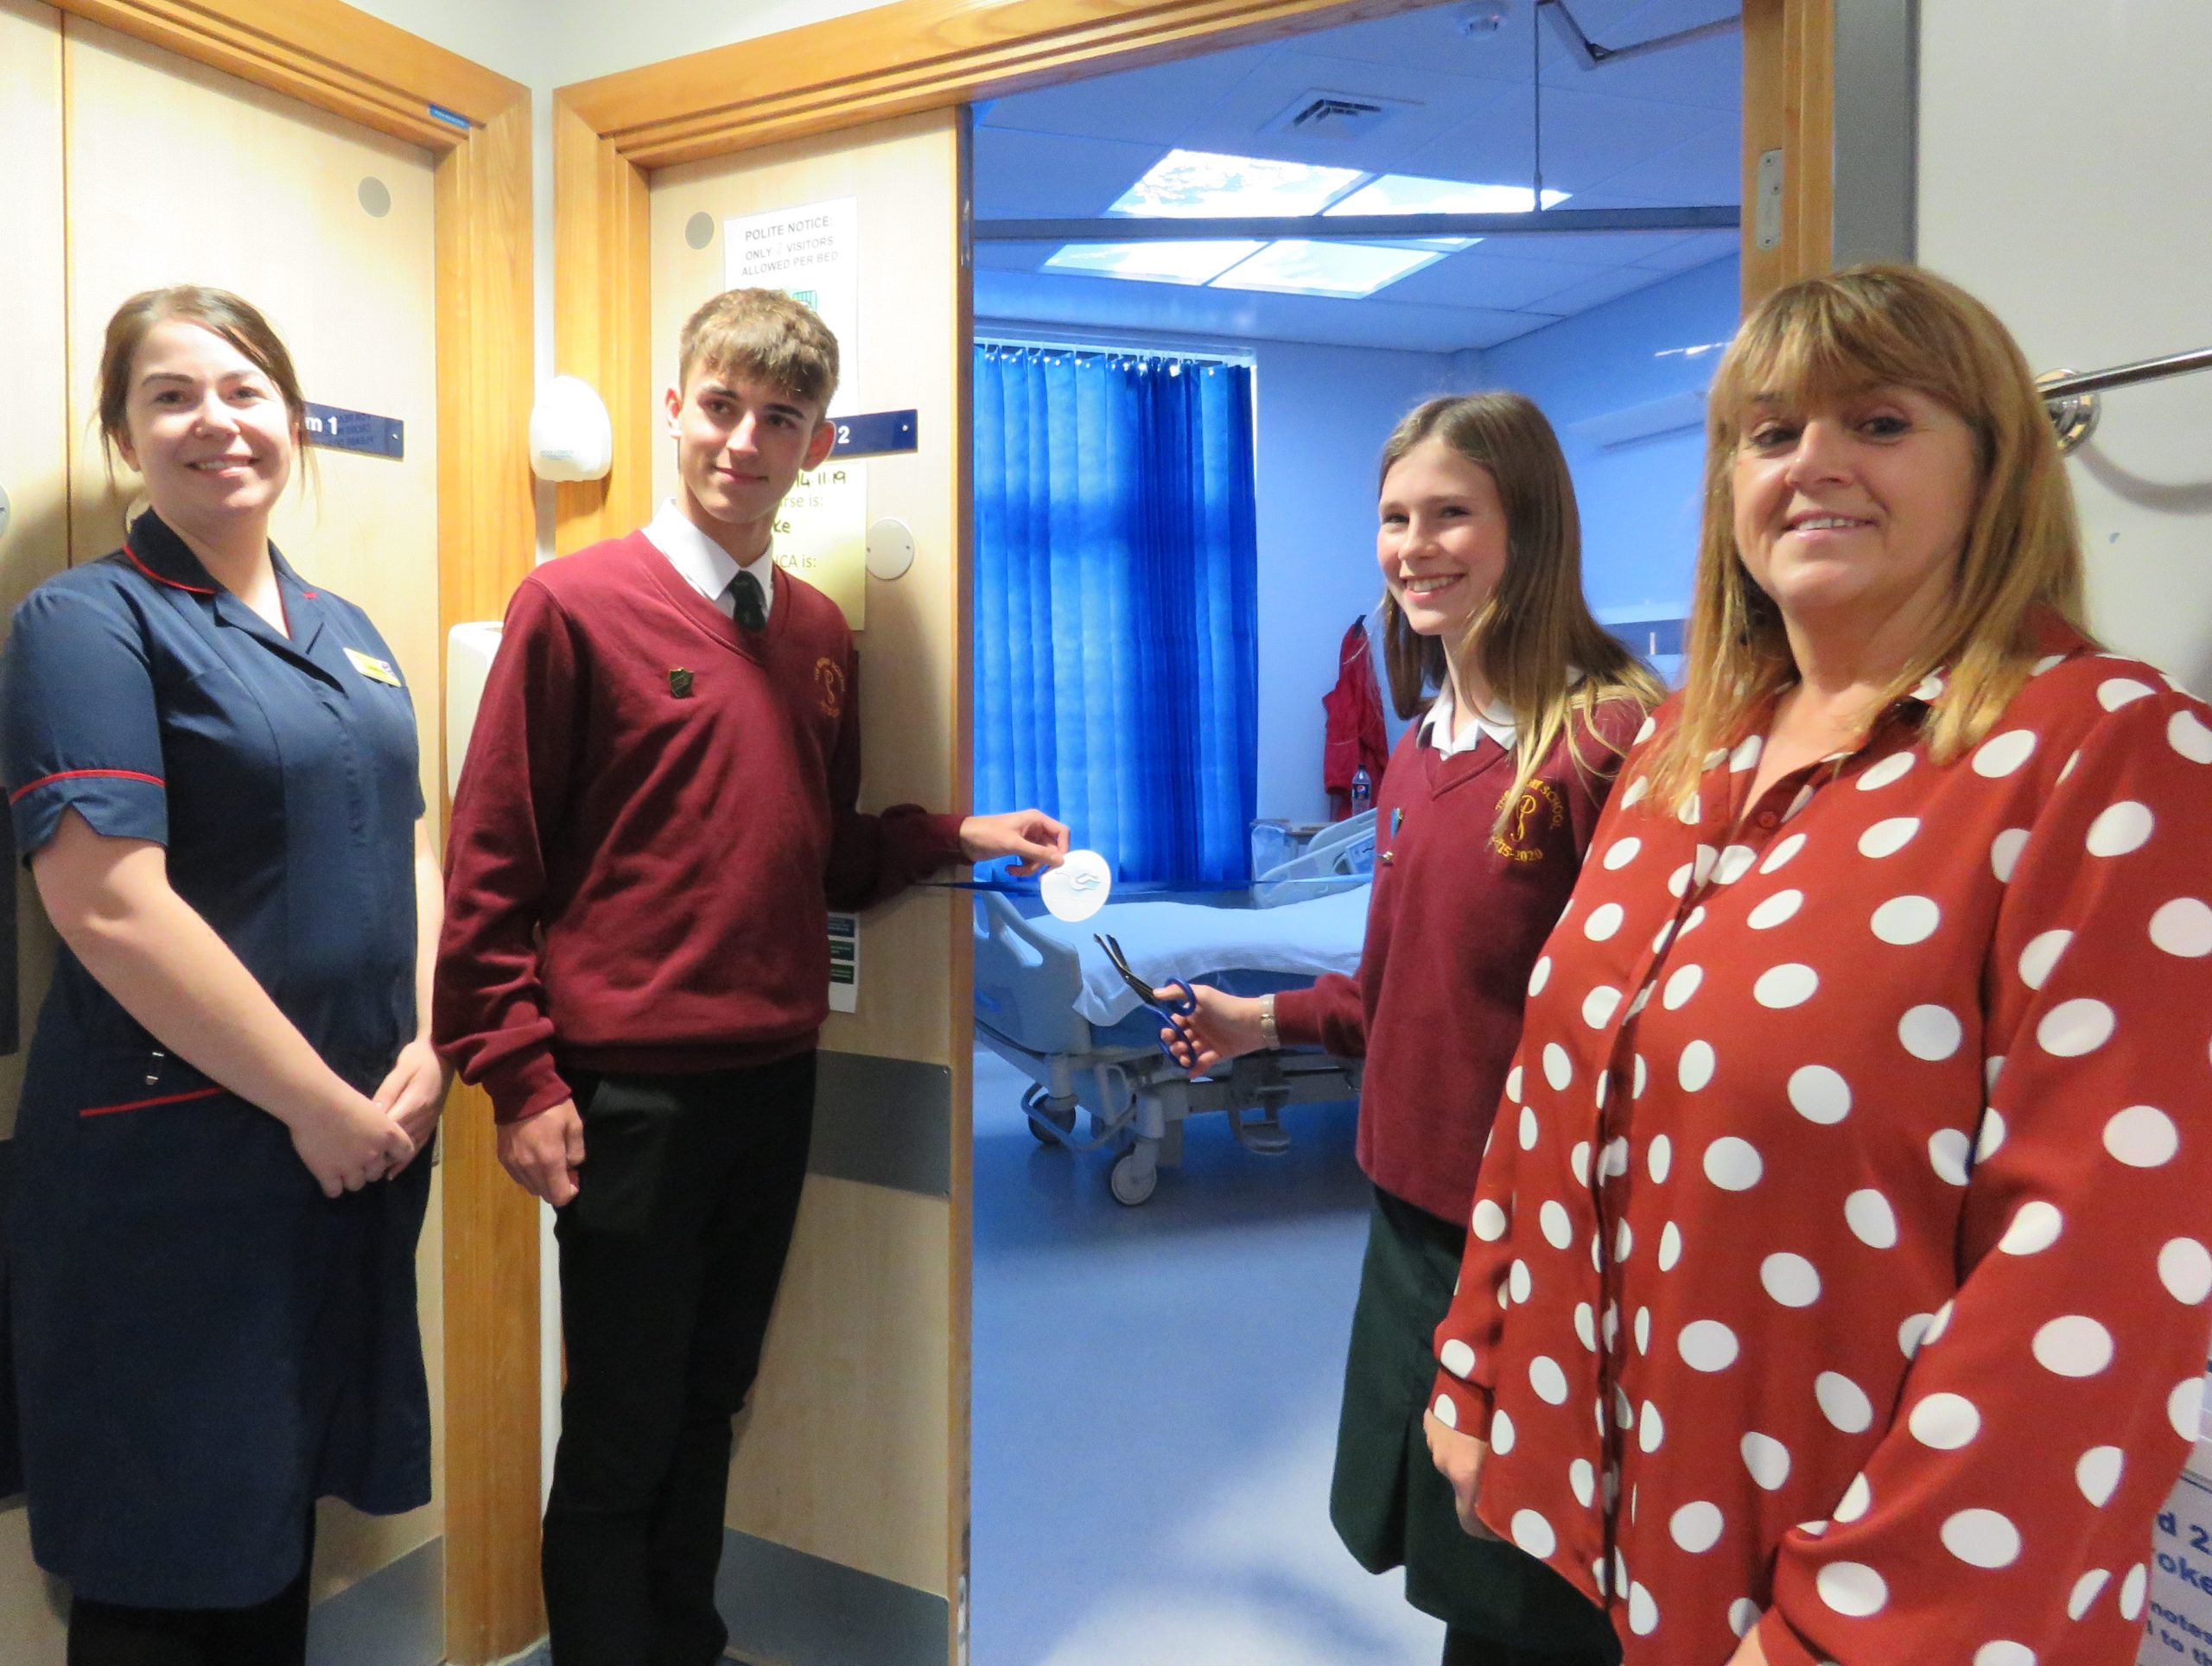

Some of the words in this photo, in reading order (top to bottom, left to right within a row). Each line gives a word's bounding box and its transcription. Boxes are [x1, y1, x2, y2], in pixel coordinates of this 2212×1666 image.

[746, 224, 785, 242] POLITE
[745, 247, 772, 261] ONLY
[786, 236, 834, 252] VISITORS
[741, 259, 791, 277] ALLOWED
[793, 255, 814, 267] PER
[817, 251, 839, 264] BED
[305, 416, 323, 432] m
[327, 416, 338, 435] 1
[837, 425, 850, 444] 2
[780, 495, 804, 508] rse
[802, 554, 817, 569] is:
[2157, 1510, 2177, 1537] d
[2158, 1552, 2212, 1597] oke
[2161, 1628, 2185, 1654] to
